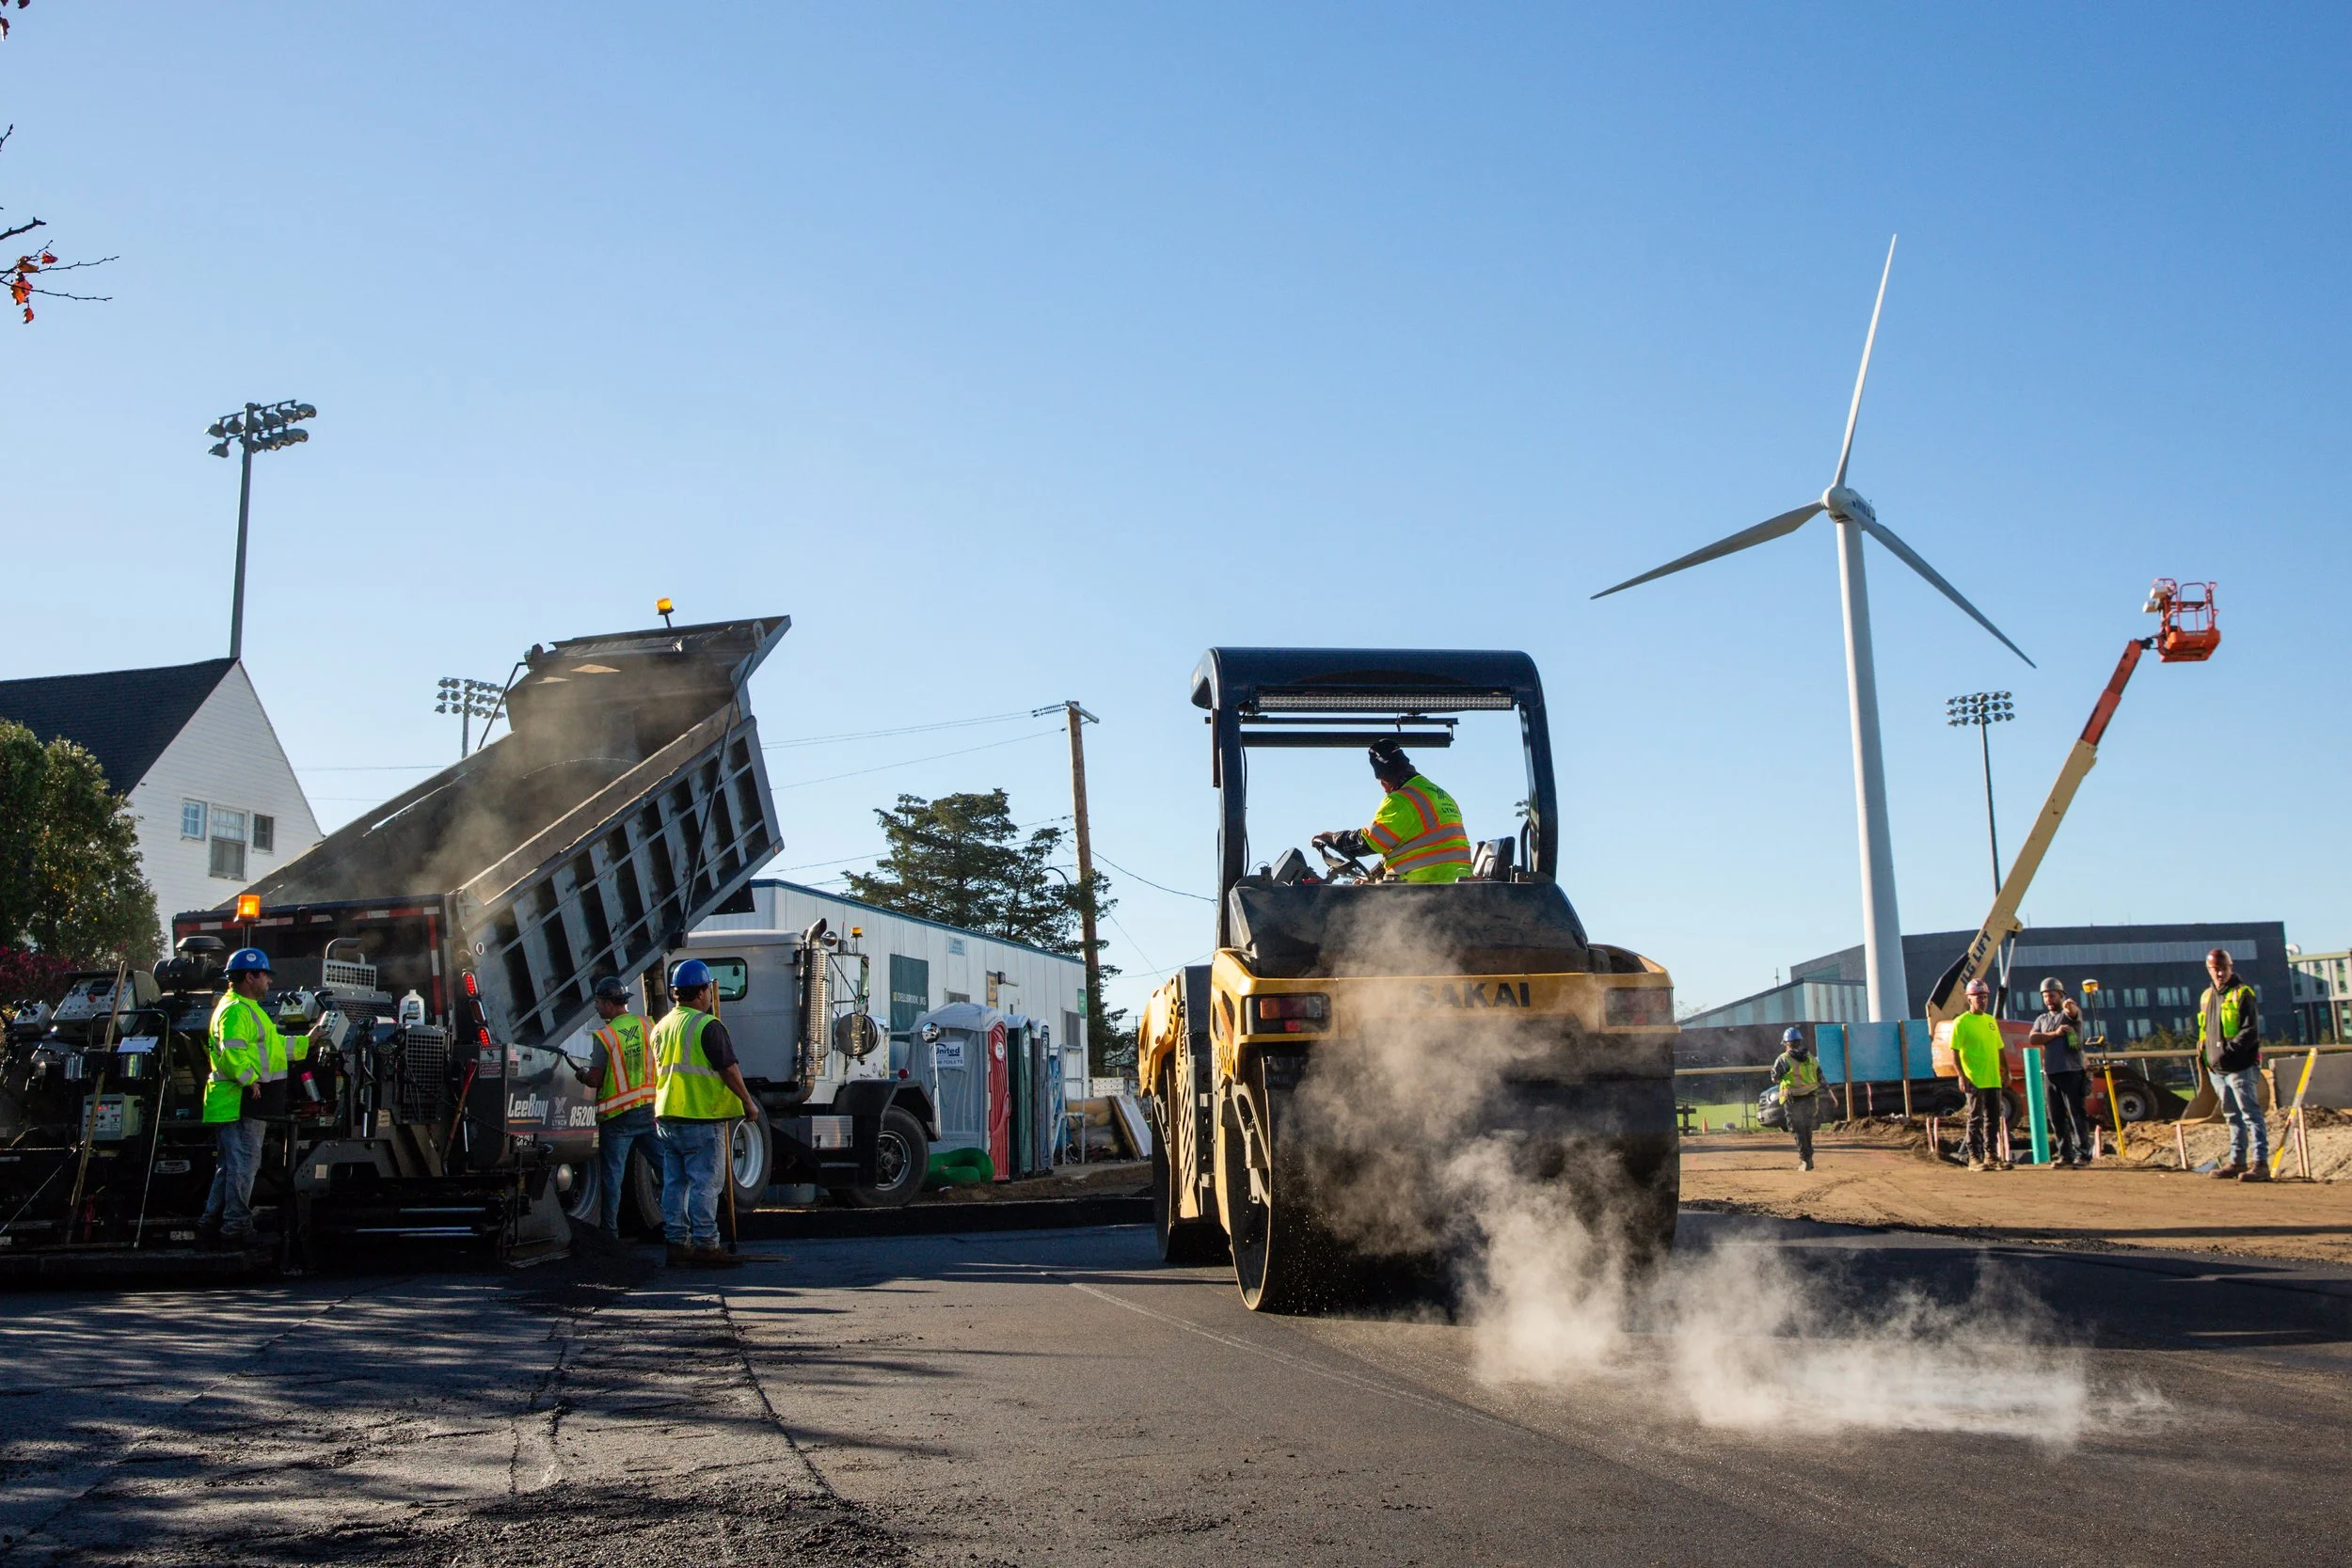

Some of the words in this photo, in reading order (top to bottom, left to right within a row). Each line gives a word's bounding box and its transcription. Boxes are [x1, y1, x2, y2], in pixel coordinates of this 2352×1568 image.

[1960, 961, 1976, 990] JLG
[1972, 930, 1992, 963] LIFT
[1413, 982, 1531, 1008] SAKAI
[935, 1046, 961, 1054] United
[508, 1093, 548, 1125] LeeBoy
